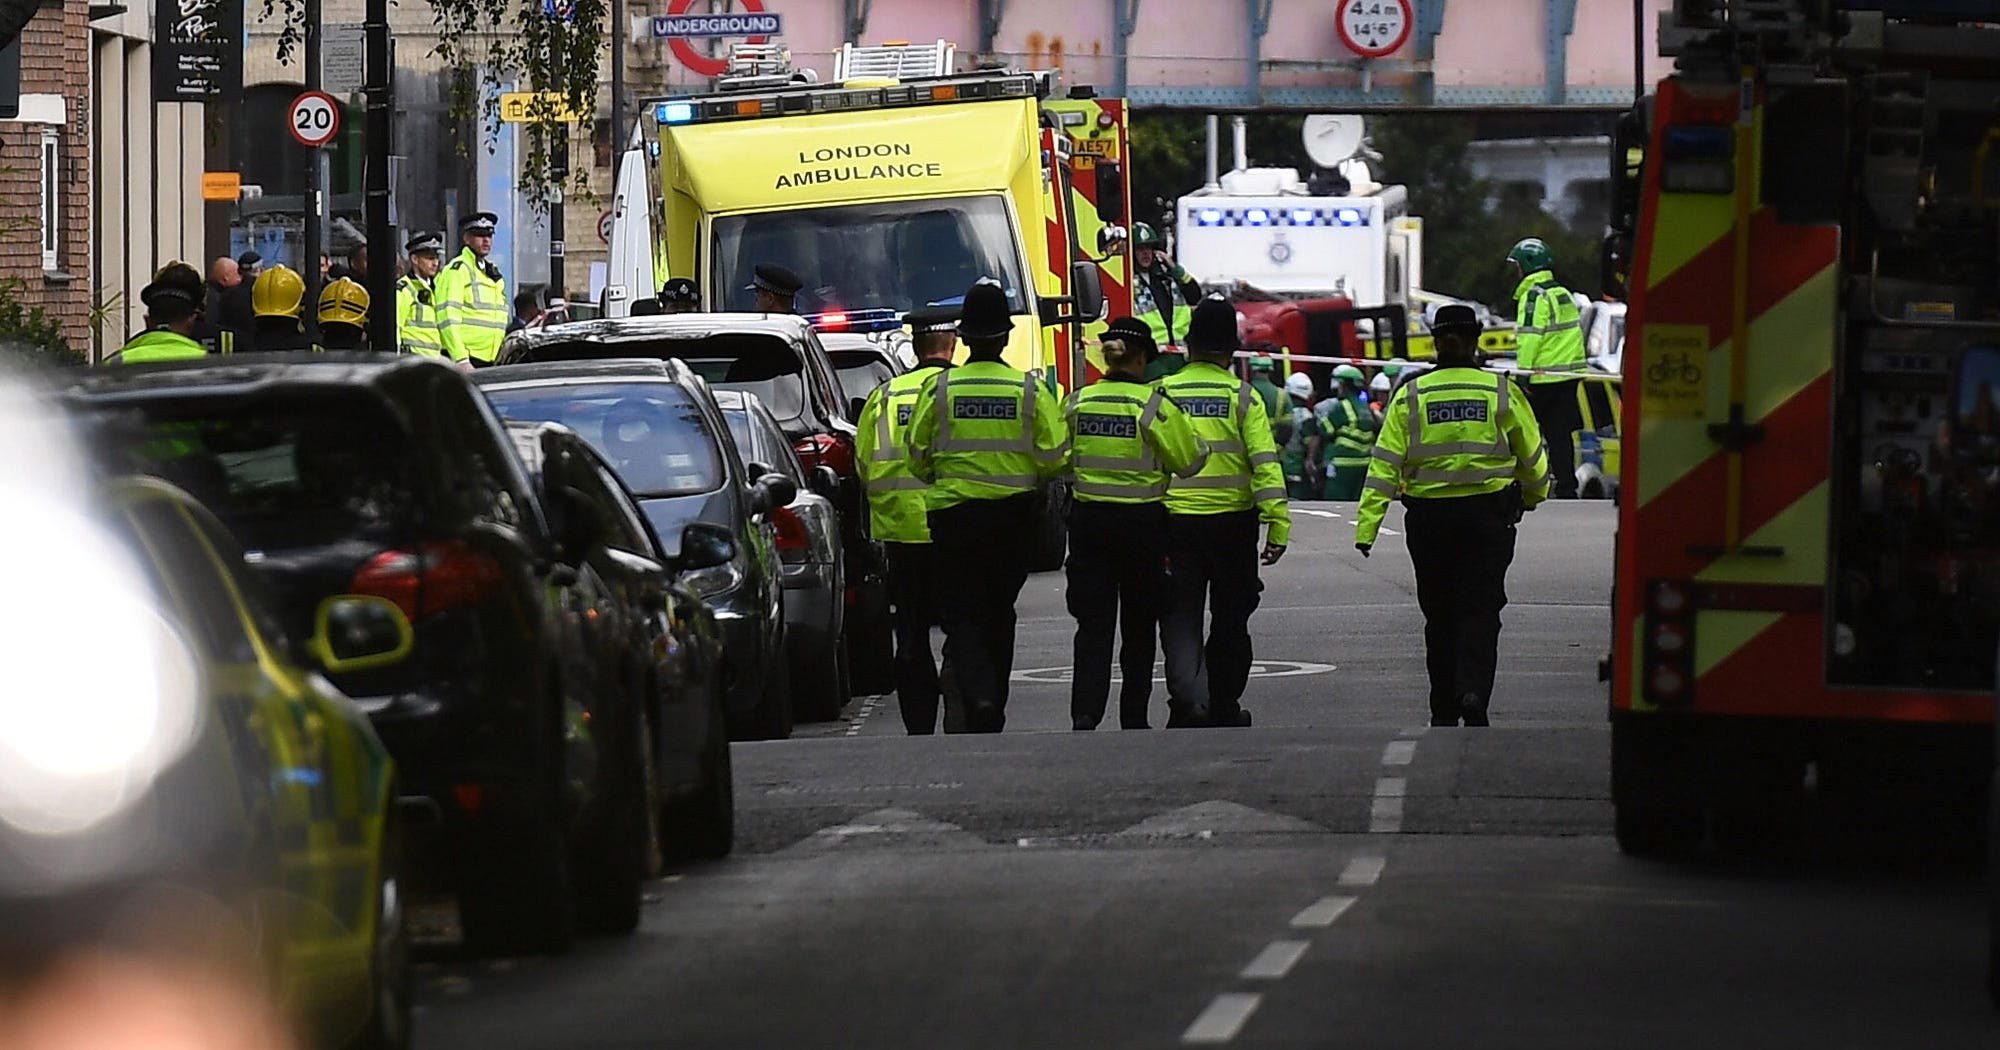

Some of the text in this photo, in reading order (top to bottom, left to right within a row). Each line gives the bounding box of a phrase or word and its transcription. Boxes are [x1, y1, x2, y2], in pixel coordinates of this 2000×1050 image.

[655, 17, 777, 34] UNDERGROUND
[297, 107, 331, 129] 20
[799, 143, 911, 163] LONDON
[775, 163, 942, 189] AMBULANCE
[955, 404, 1015, 418] POLICE
[1179, 403, 1228, 416] OLICE
[1429, 407, 1486, 422] POLICE
[1079, 421, 1135, 437] POLICE
